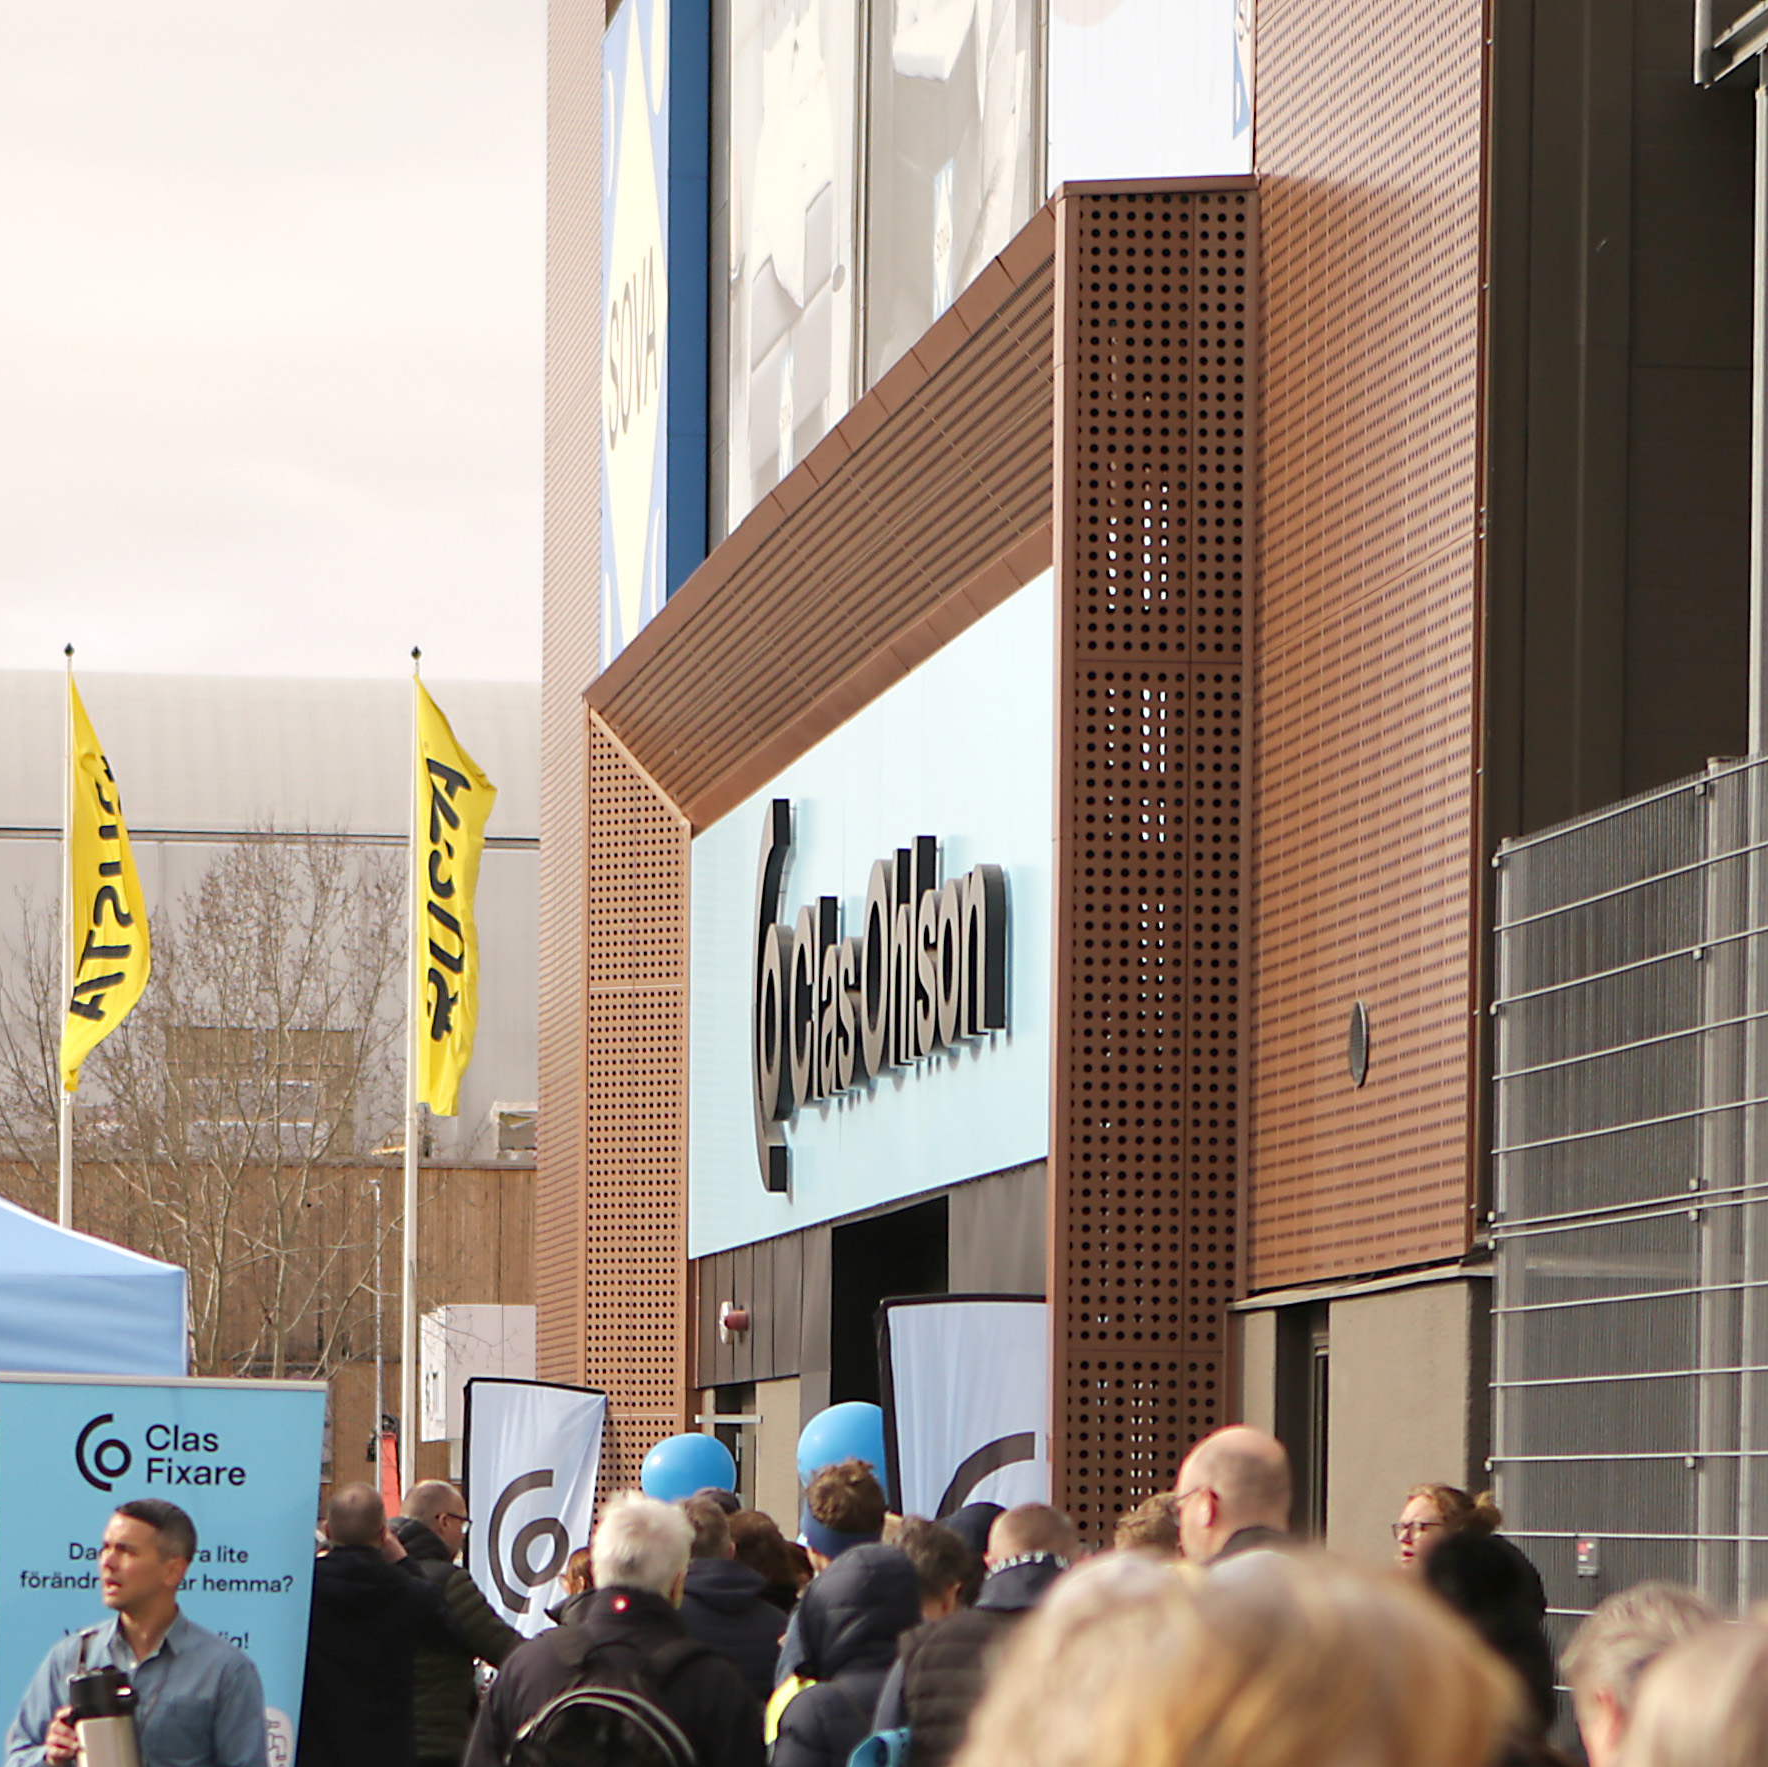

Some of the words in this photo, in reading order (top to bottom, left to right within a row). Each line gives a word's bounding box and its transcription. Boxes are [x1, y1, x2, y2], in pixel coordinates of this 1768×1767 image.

[608, 246, 658, 451] SOVA
[790, 894, 856, 1108] Clas
[861, 834, 1007, 1079] Ohlson
[145, 1423, 219, 1453] Clas
[146, 1457, 246, 1486] Fixare
[216, 1544, 249, 1564] lite
[20, 1571, 101, 1590] förändr
[203, 1573, 294, 1593] hemma?
